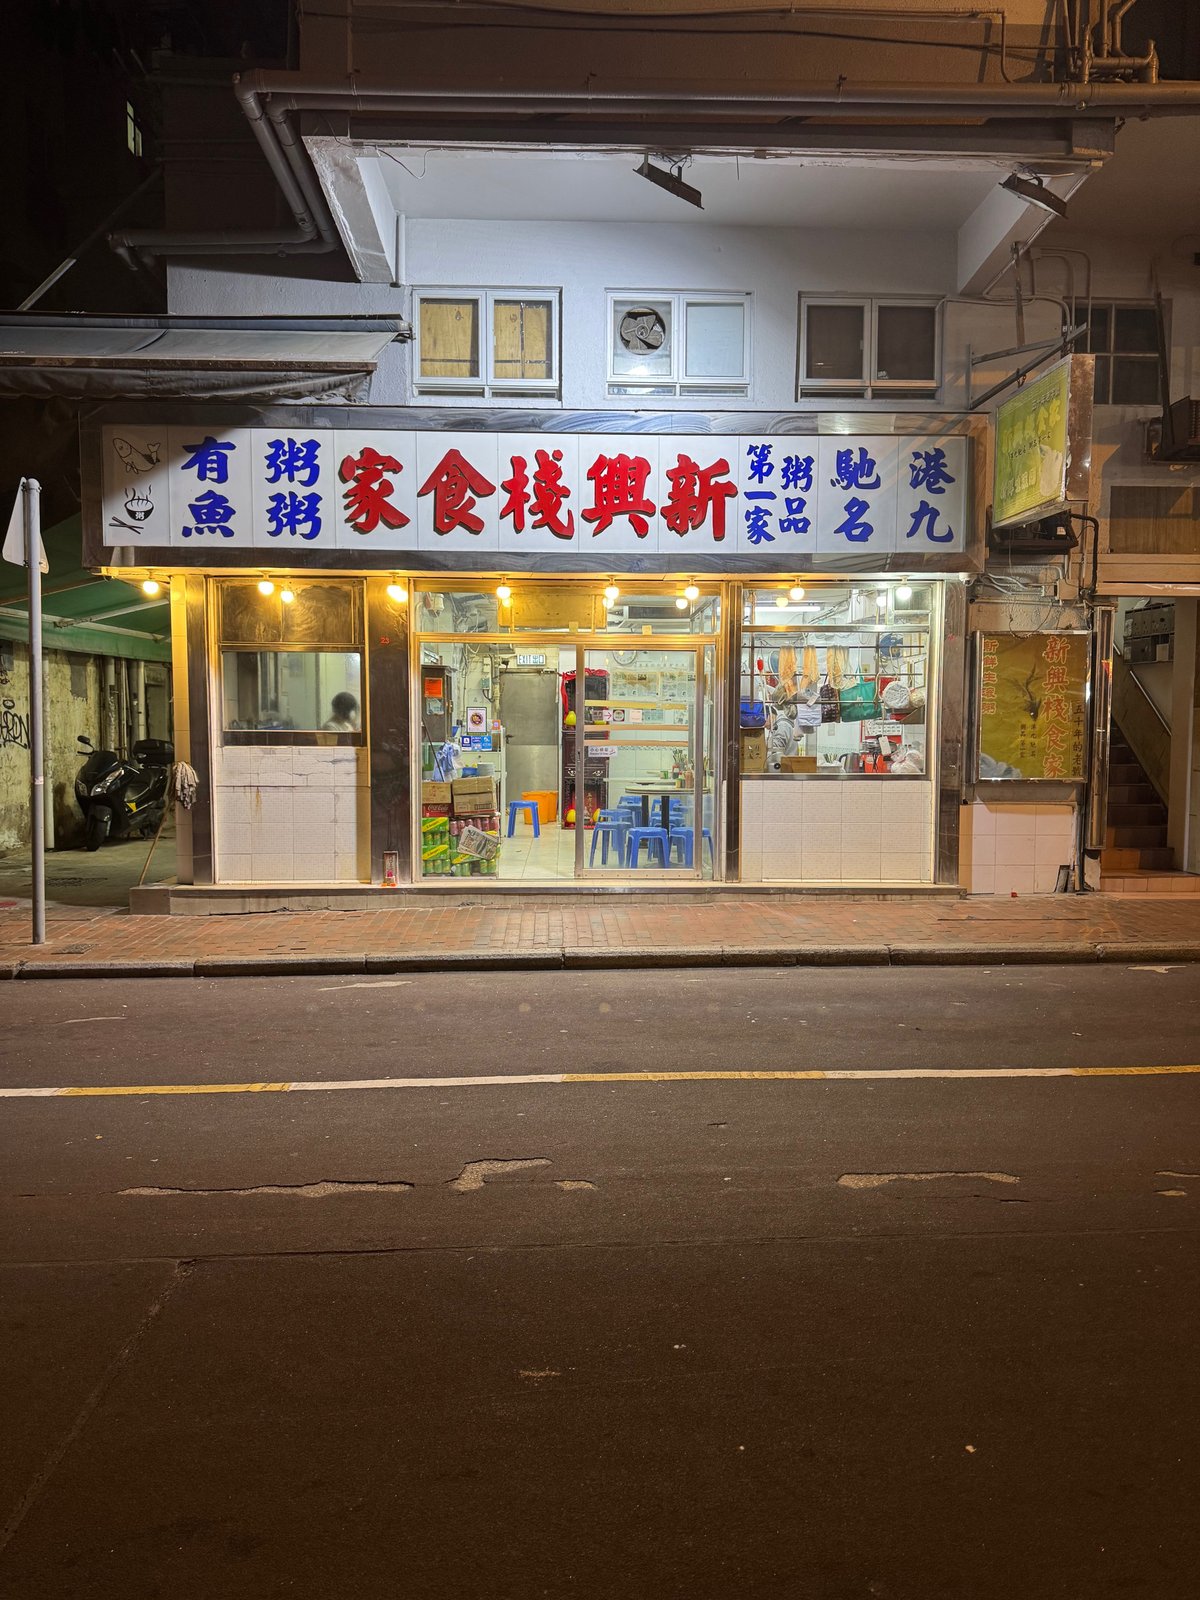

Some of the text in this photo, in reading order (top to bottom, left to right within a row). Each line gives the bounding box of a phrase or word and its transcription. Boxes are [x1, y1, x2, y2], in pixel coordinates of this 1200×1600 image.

[181, 435, 237, 538] 有魚
[264, 437, 323, 541] 粥粥
[338, 446, 738, 542] 新興棧食家
[743, 444, 776, 545] 第一家
[778, 453, 815, 535] 粥品
[830, 447, 881, 542] 馳名
[906, 448, 956, 543] 港九
[519, 655, 544, 664] EXIT 出口
[1041, 635, 1071, 778] 新興棧食家
